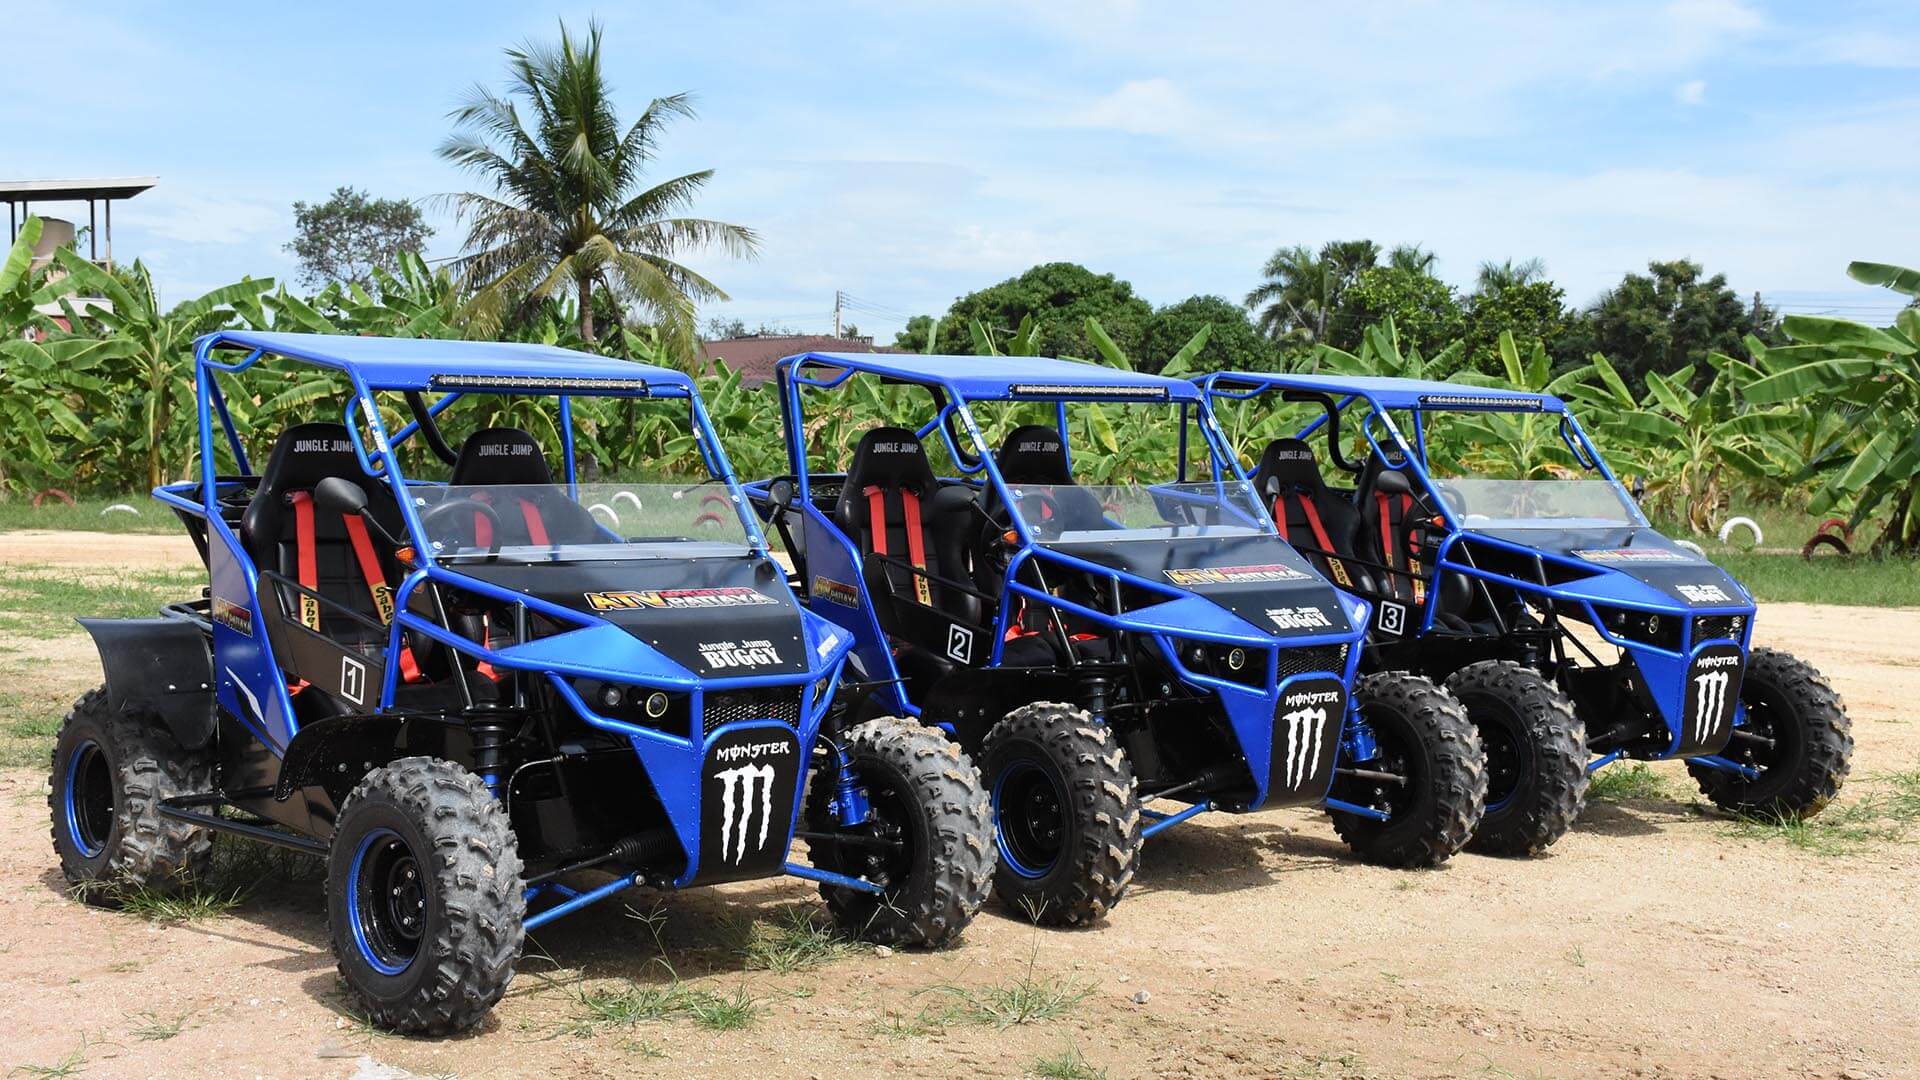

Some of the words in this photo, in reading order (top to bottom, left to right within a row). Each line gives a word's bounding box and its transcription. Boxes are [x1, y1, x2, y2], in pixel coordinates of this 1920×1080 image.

[294, 440, 328, 453] JUNGLE
[478, 444, 508, 456] JUNGLE
[511, 444, 533, 456] JUMP
[873, 443, 898, 453] JUNGLE
[900, 443, 918, 453] JUMP
[1018, 442, 1041, 452] JUNGLE
[1042, 442, 1059, 453] JUMP
[586, 590, 669, 611] ATV
[665, 593, 778, 608] PATTAYA
[1270, 612, 1332, 629] BUGGY
[1385, 607, 1398, 629] 3
[698, 640, 737, 651] Jungle
[741, 639, 772, 649] Jump
[953, 631, 966, 658] 2
[702, 647, 784, 669] BUGGY
[1696, 655, 1739, 668] MONSTER
[347, 666, 356, 695] 1
[1285, 691, 1339, 707] MONSTER
[716, 741, 791, 762] MONSTER
